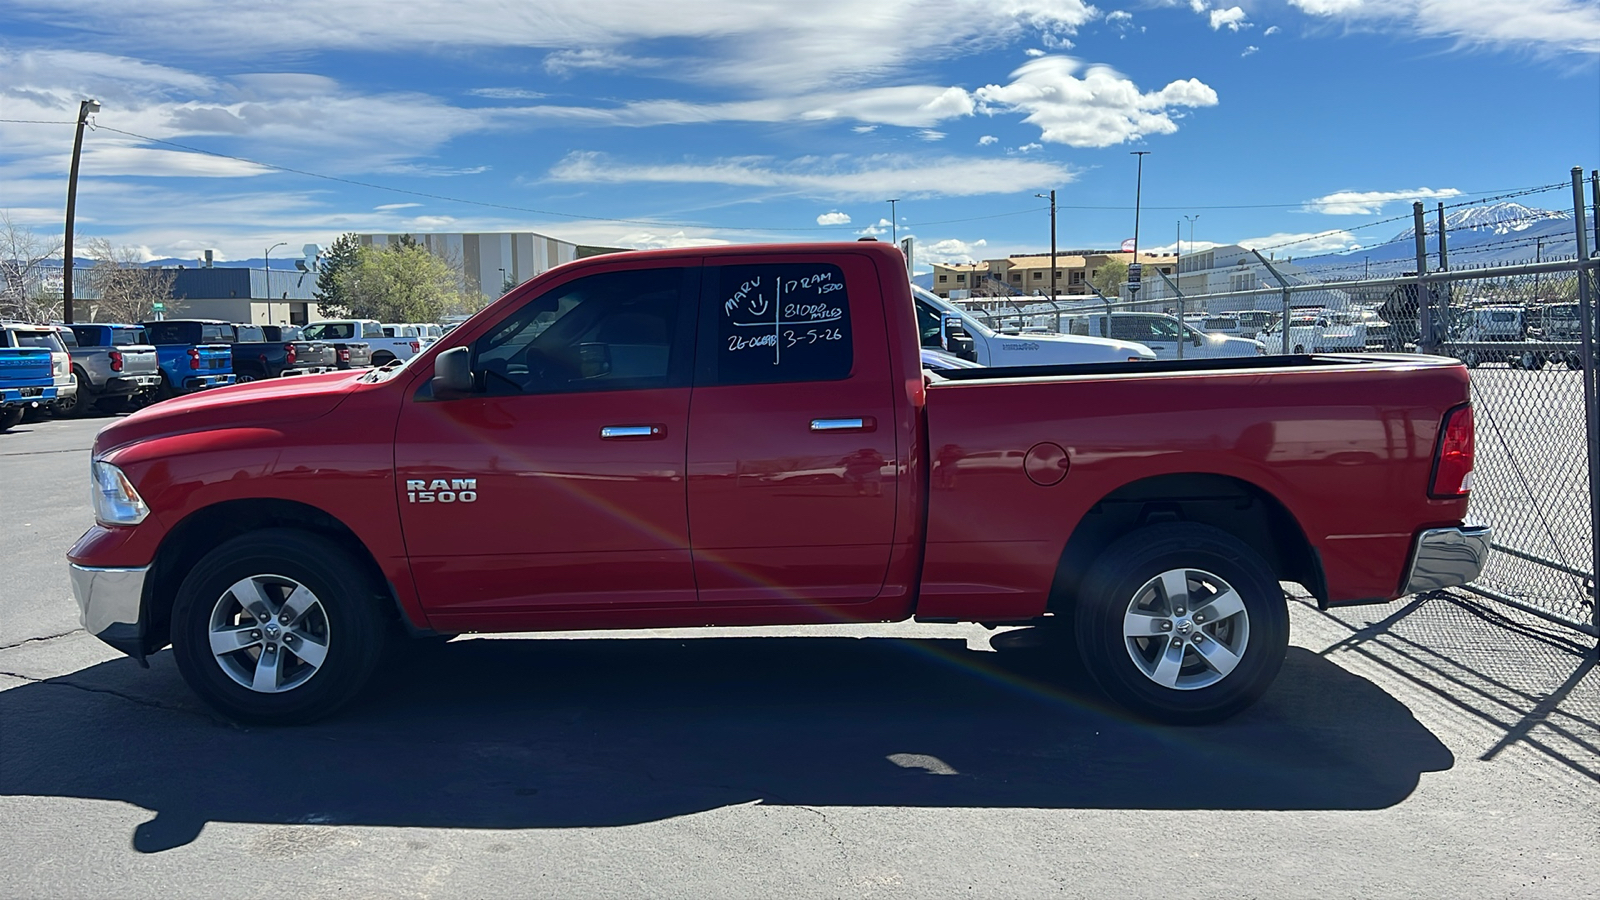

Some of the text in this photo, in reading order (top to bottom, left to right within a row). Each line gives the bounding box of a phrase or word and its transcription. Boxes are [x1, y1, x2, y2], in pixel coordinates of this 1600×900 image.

[801, 272, 832, 289] RAM
[725, 275, 761, 317] MARV
[818, 283, 843, 294] 1500
[784, 303, 827, 318] 81000
[783, 328, 842, 348] 3-5-26
[406, 478, 477, 491] RAM
[407, 491, 477, 503] 1500
